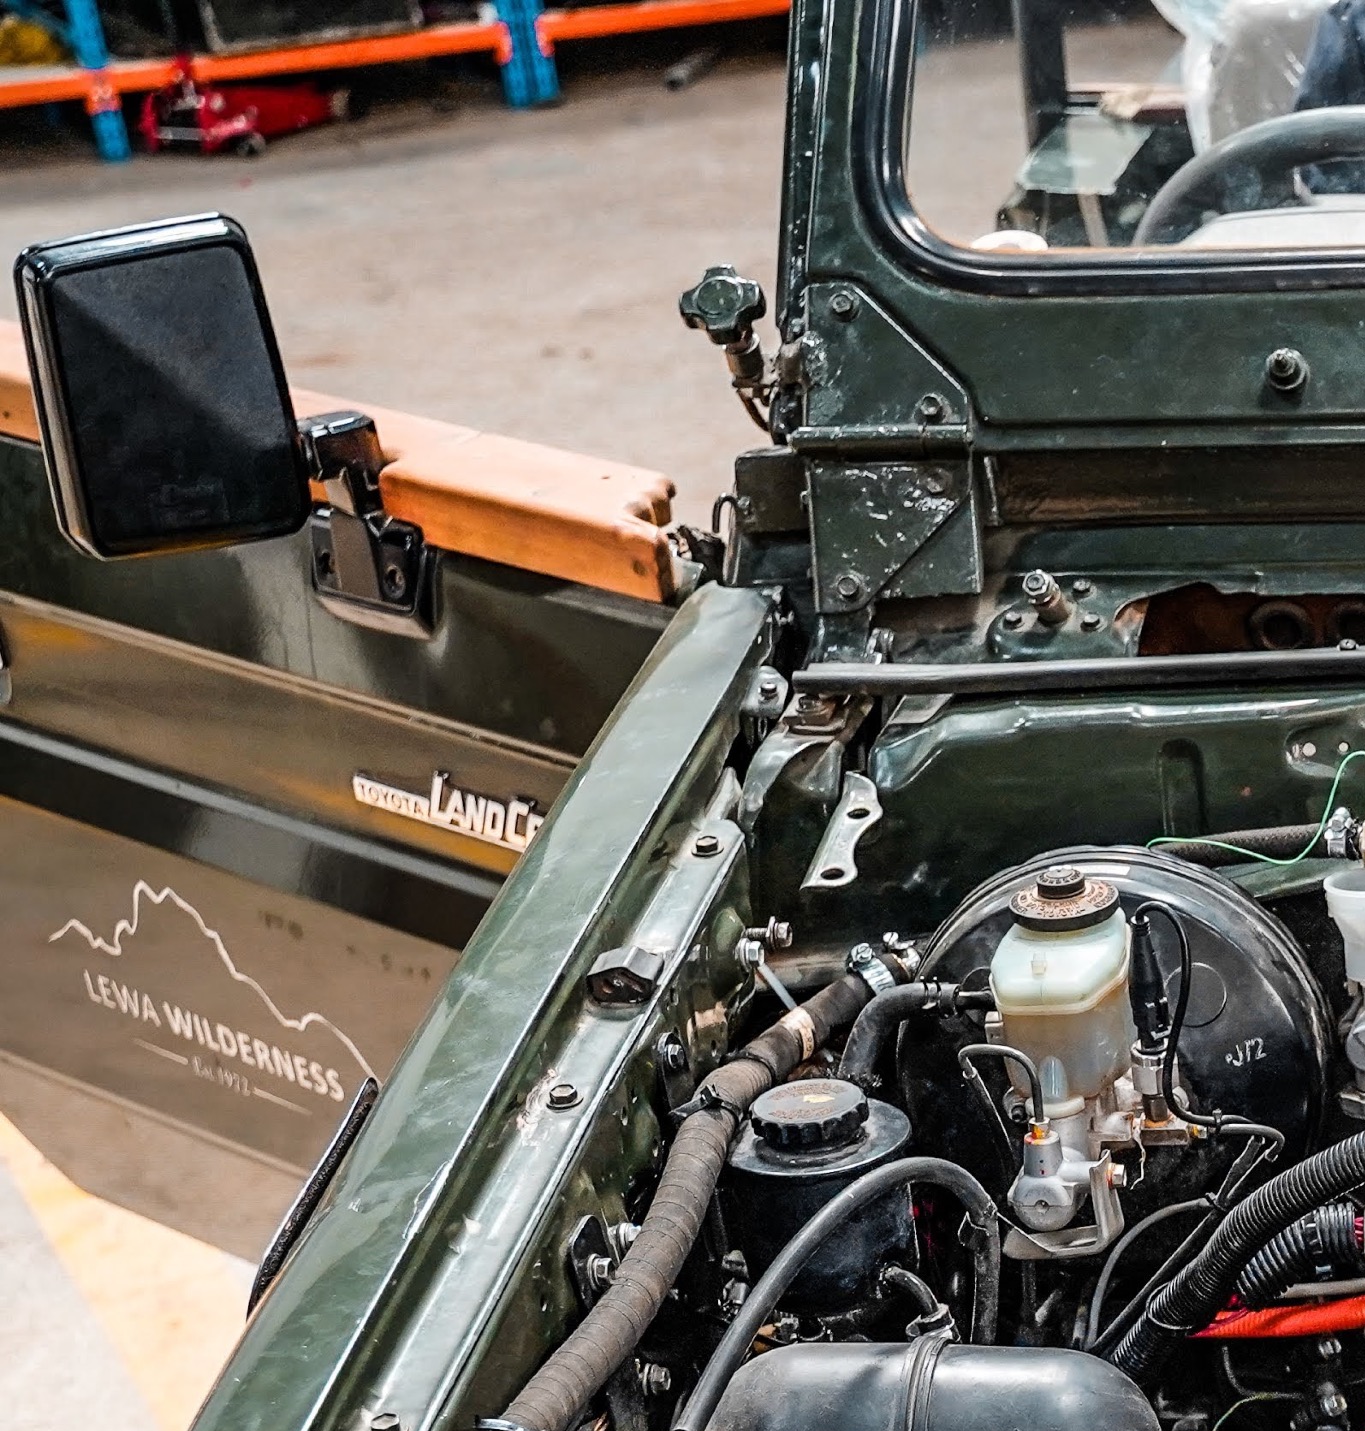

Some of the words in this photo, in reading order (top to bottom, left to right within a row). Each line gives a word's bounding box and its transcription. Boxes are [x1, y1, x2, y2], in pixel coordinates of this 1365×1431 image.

[358, 782, 423, 818] TOYOTA
[431, 772, 506, 840] LAND
[84, 969, 162, 1028] LEWA
[163, 1001, 345, 1102] WILDERNESS
